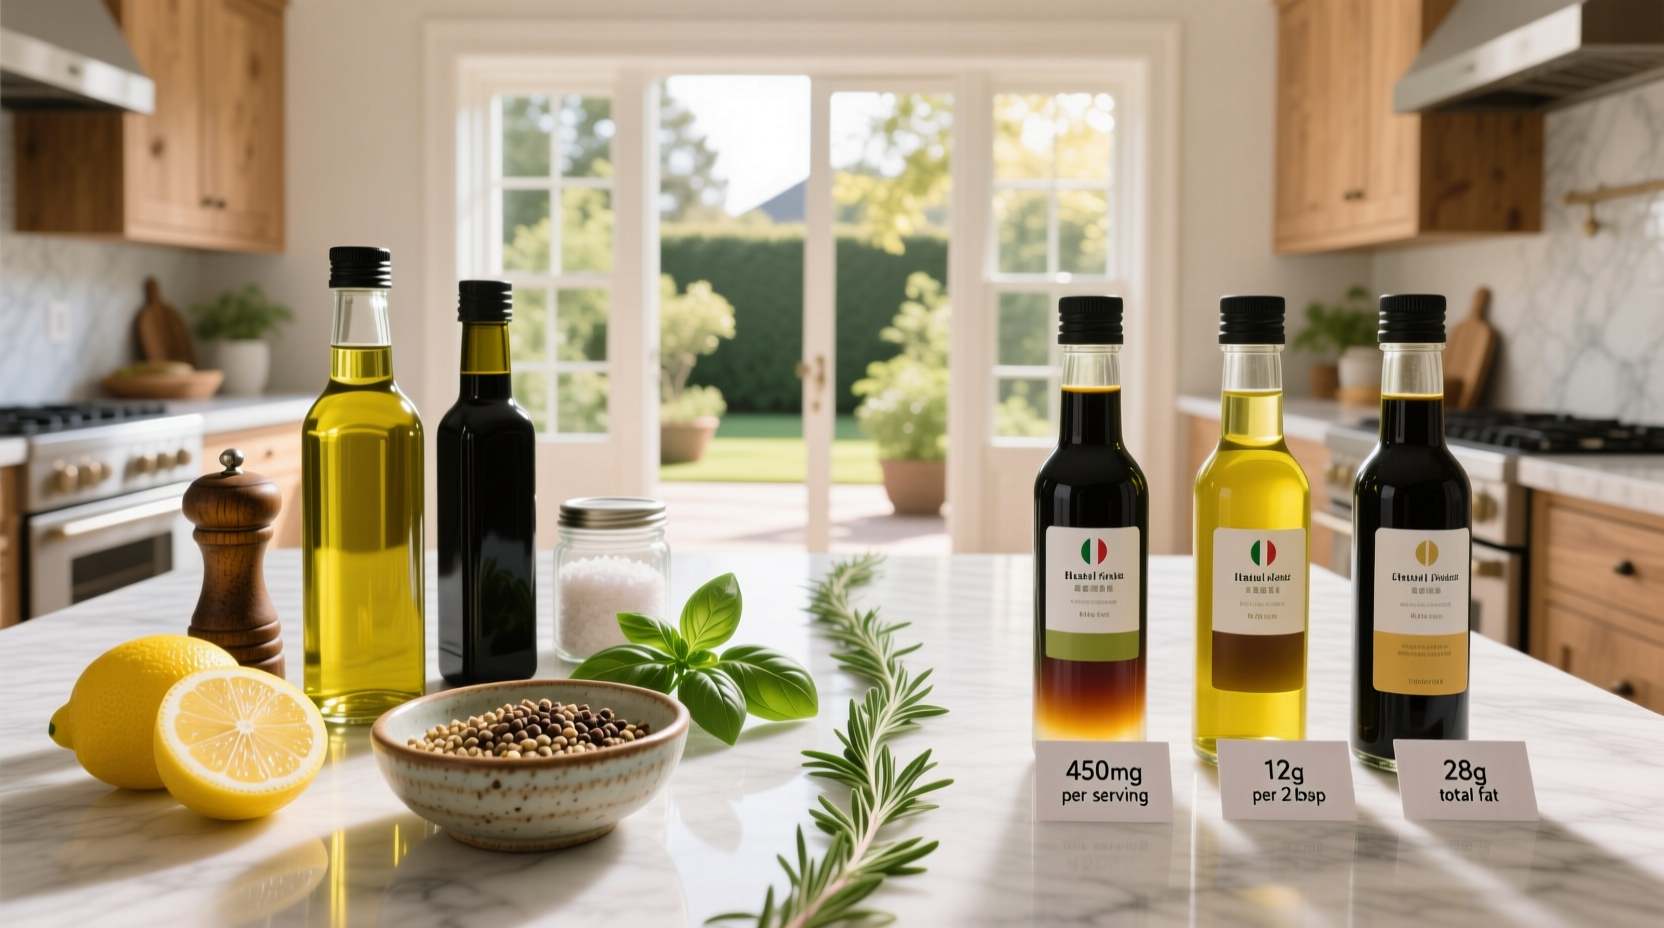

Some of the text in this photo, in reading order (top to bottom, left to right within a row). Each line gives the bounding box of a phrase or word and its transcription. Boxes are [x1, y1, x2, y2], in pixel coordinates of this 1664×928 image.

[1065, 759, 1142, 786] 450mg
[1264, 758, 1304, 786] 12g
[1443, 758, 1487, 786] 28g
[1062, 786, 1149, 807] per serving
[1252, 790, 1277, 806] per
[1281, 786, 1292, 802] 2
[1439, 785, 1499, 802] total fat
